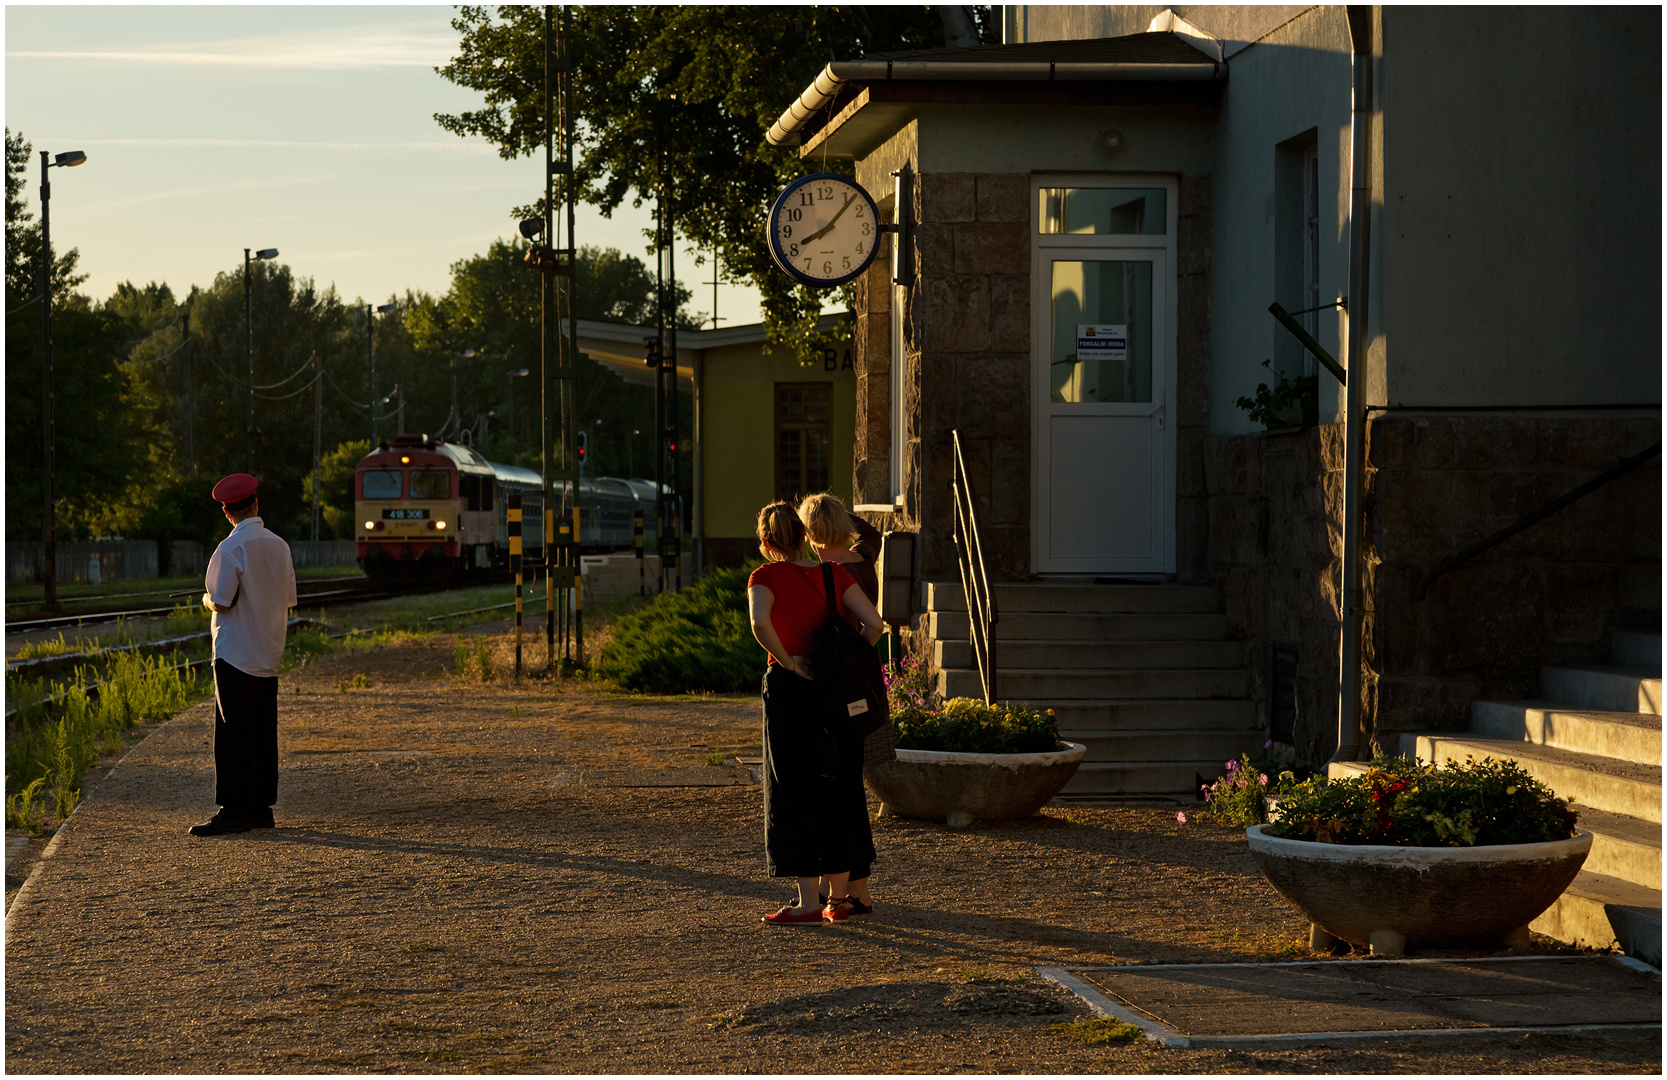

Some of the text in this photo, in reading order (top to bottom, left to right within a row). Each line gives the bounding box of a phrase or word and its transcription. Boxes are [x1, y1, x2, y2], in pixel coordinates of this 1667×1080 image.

[800, 192, 815, 206] 11
[816, 186, 834, 200] 12
[842, 192, 849, 206] 1
[787, 208, 802, 222] 10
[855, 204, 864, 218] 2
[783, 225, 792, 238] 9
[862, 222, 870, 236] 3
[790, 243, 799, 256] 8
[855, 241, 864, 254] 4
[803, 257, 812, 270] 7
[823, 261, 832, 274] 6
[842, 256, 850, 269] 5
[389, 510, 424, 519] 418 306
